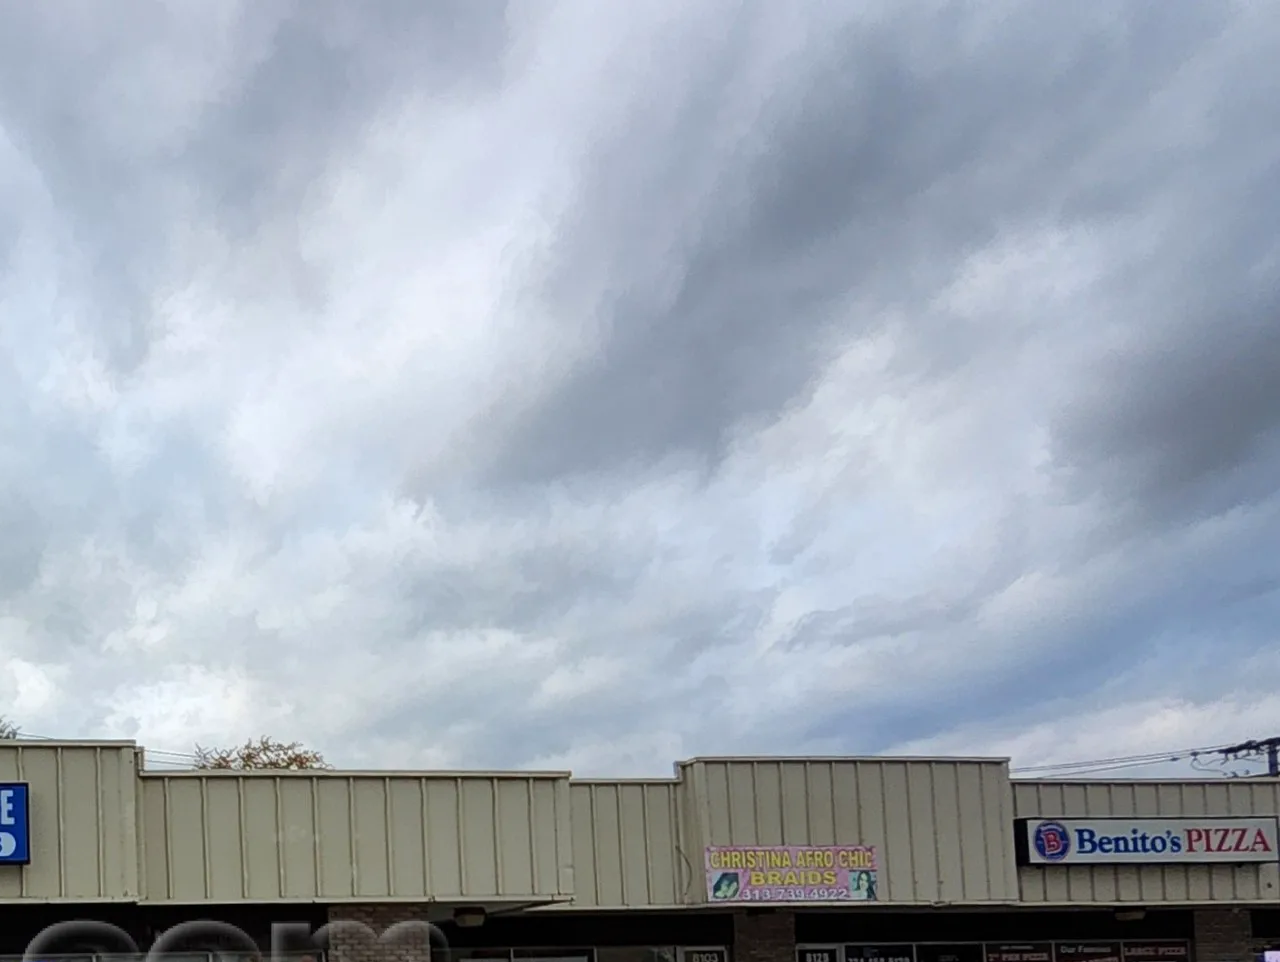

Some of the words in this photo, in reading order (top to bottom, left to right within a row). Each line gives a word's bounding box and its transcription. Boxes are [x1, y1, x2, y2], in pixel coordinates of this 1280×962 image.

[1074, 828, 1182, 854] Benito's
[1183, 828, 1272, 853] PIZZA
[710, 850, 790, 868] CHRISTINA
[795, 850, 834, 868] AFRO
[839, 850, 873, 867] CHIC
[750, 871, 837, 886] BRAIDS
